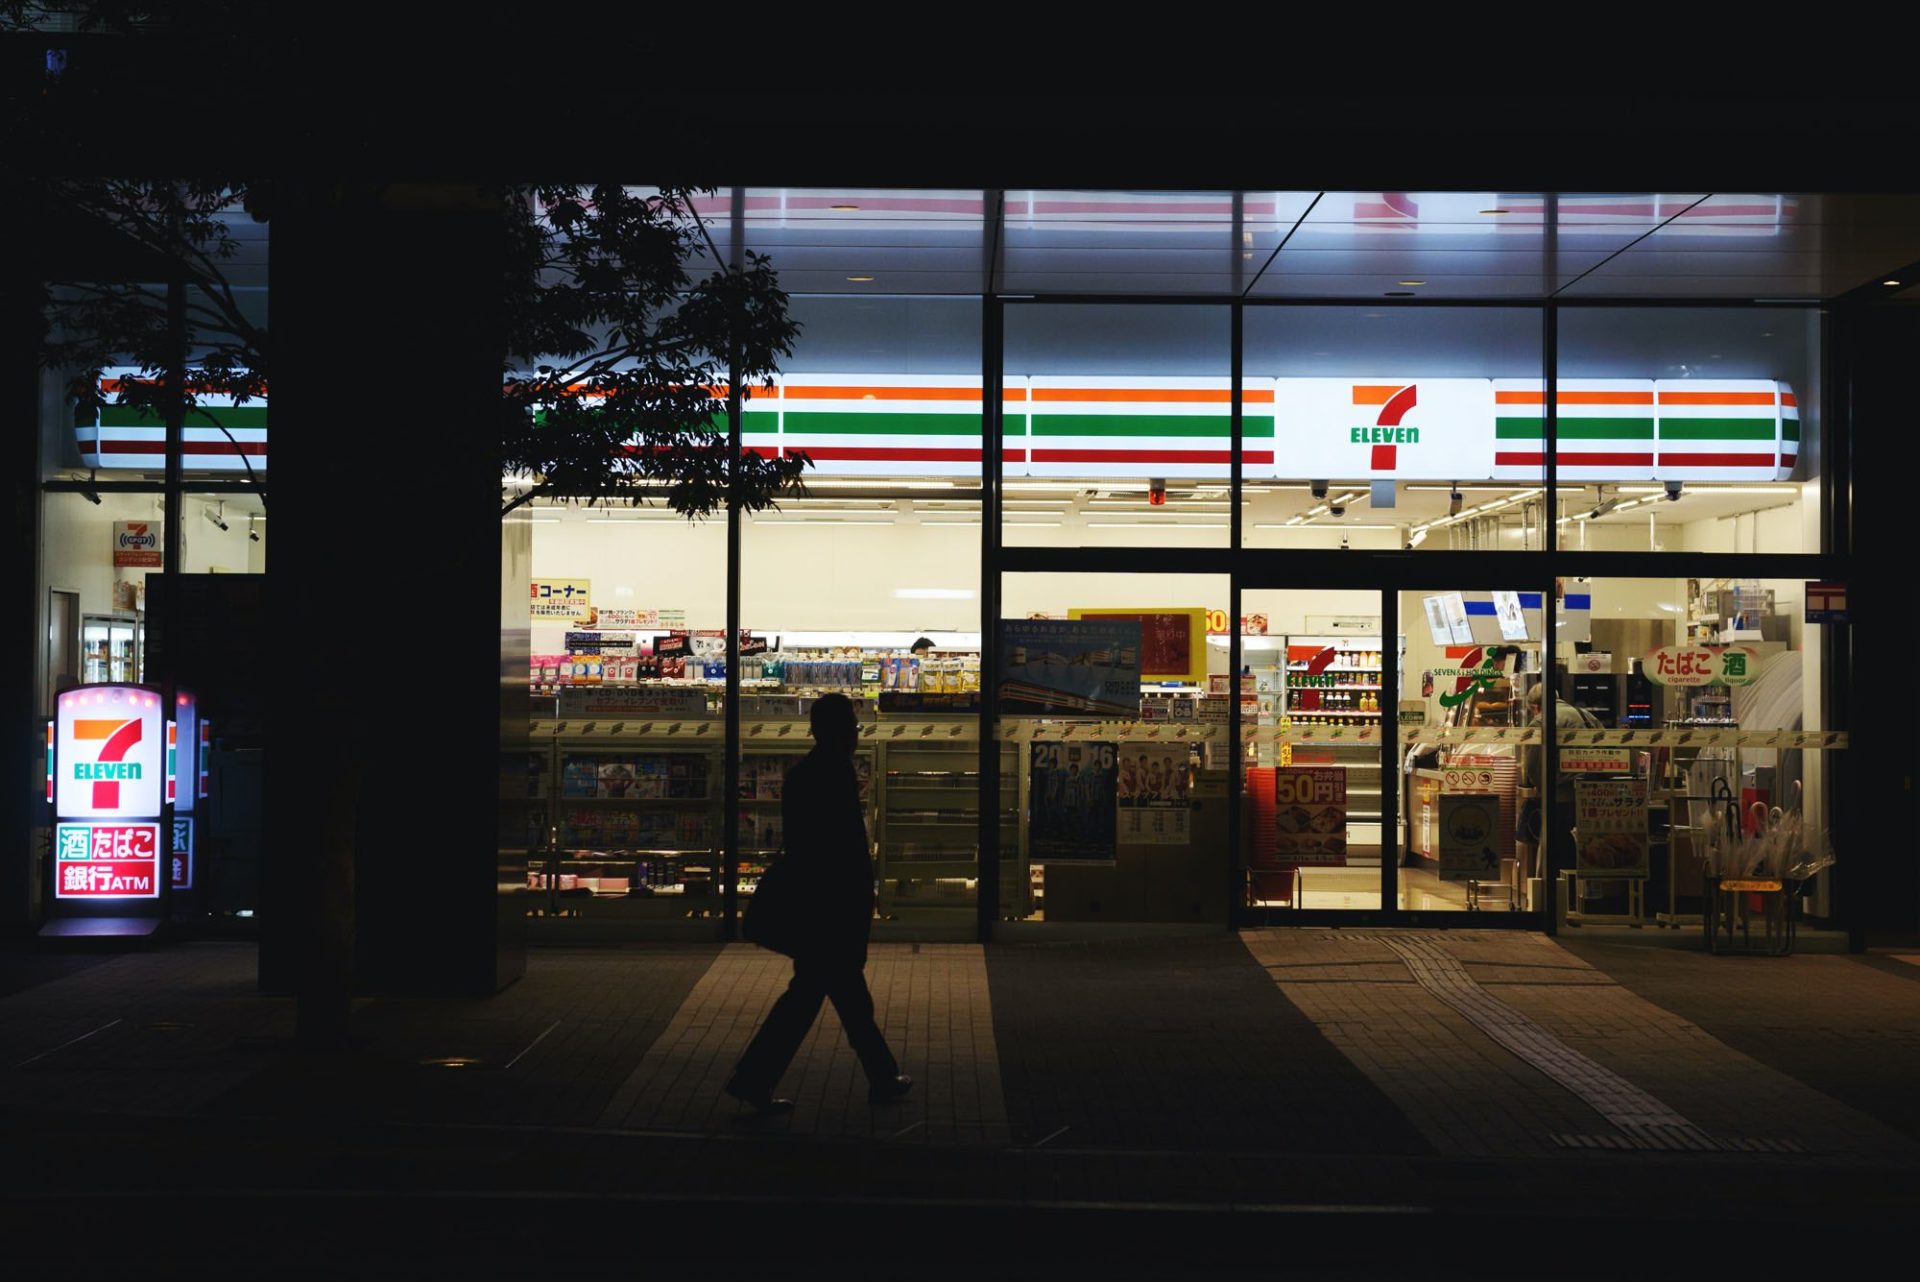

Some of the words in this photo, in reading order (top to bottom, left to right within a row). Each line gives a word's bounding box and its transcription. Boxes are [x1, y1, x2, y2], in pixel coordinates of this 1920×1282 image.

[1657, 652, 1711, 675] たばこ
[1722, 652, 1746, 676] 酒
[1667, 676, 1701, 684] cigarette
[61, 829, 88, 859] 酒
[92, 828, 153, 858] たばこ
